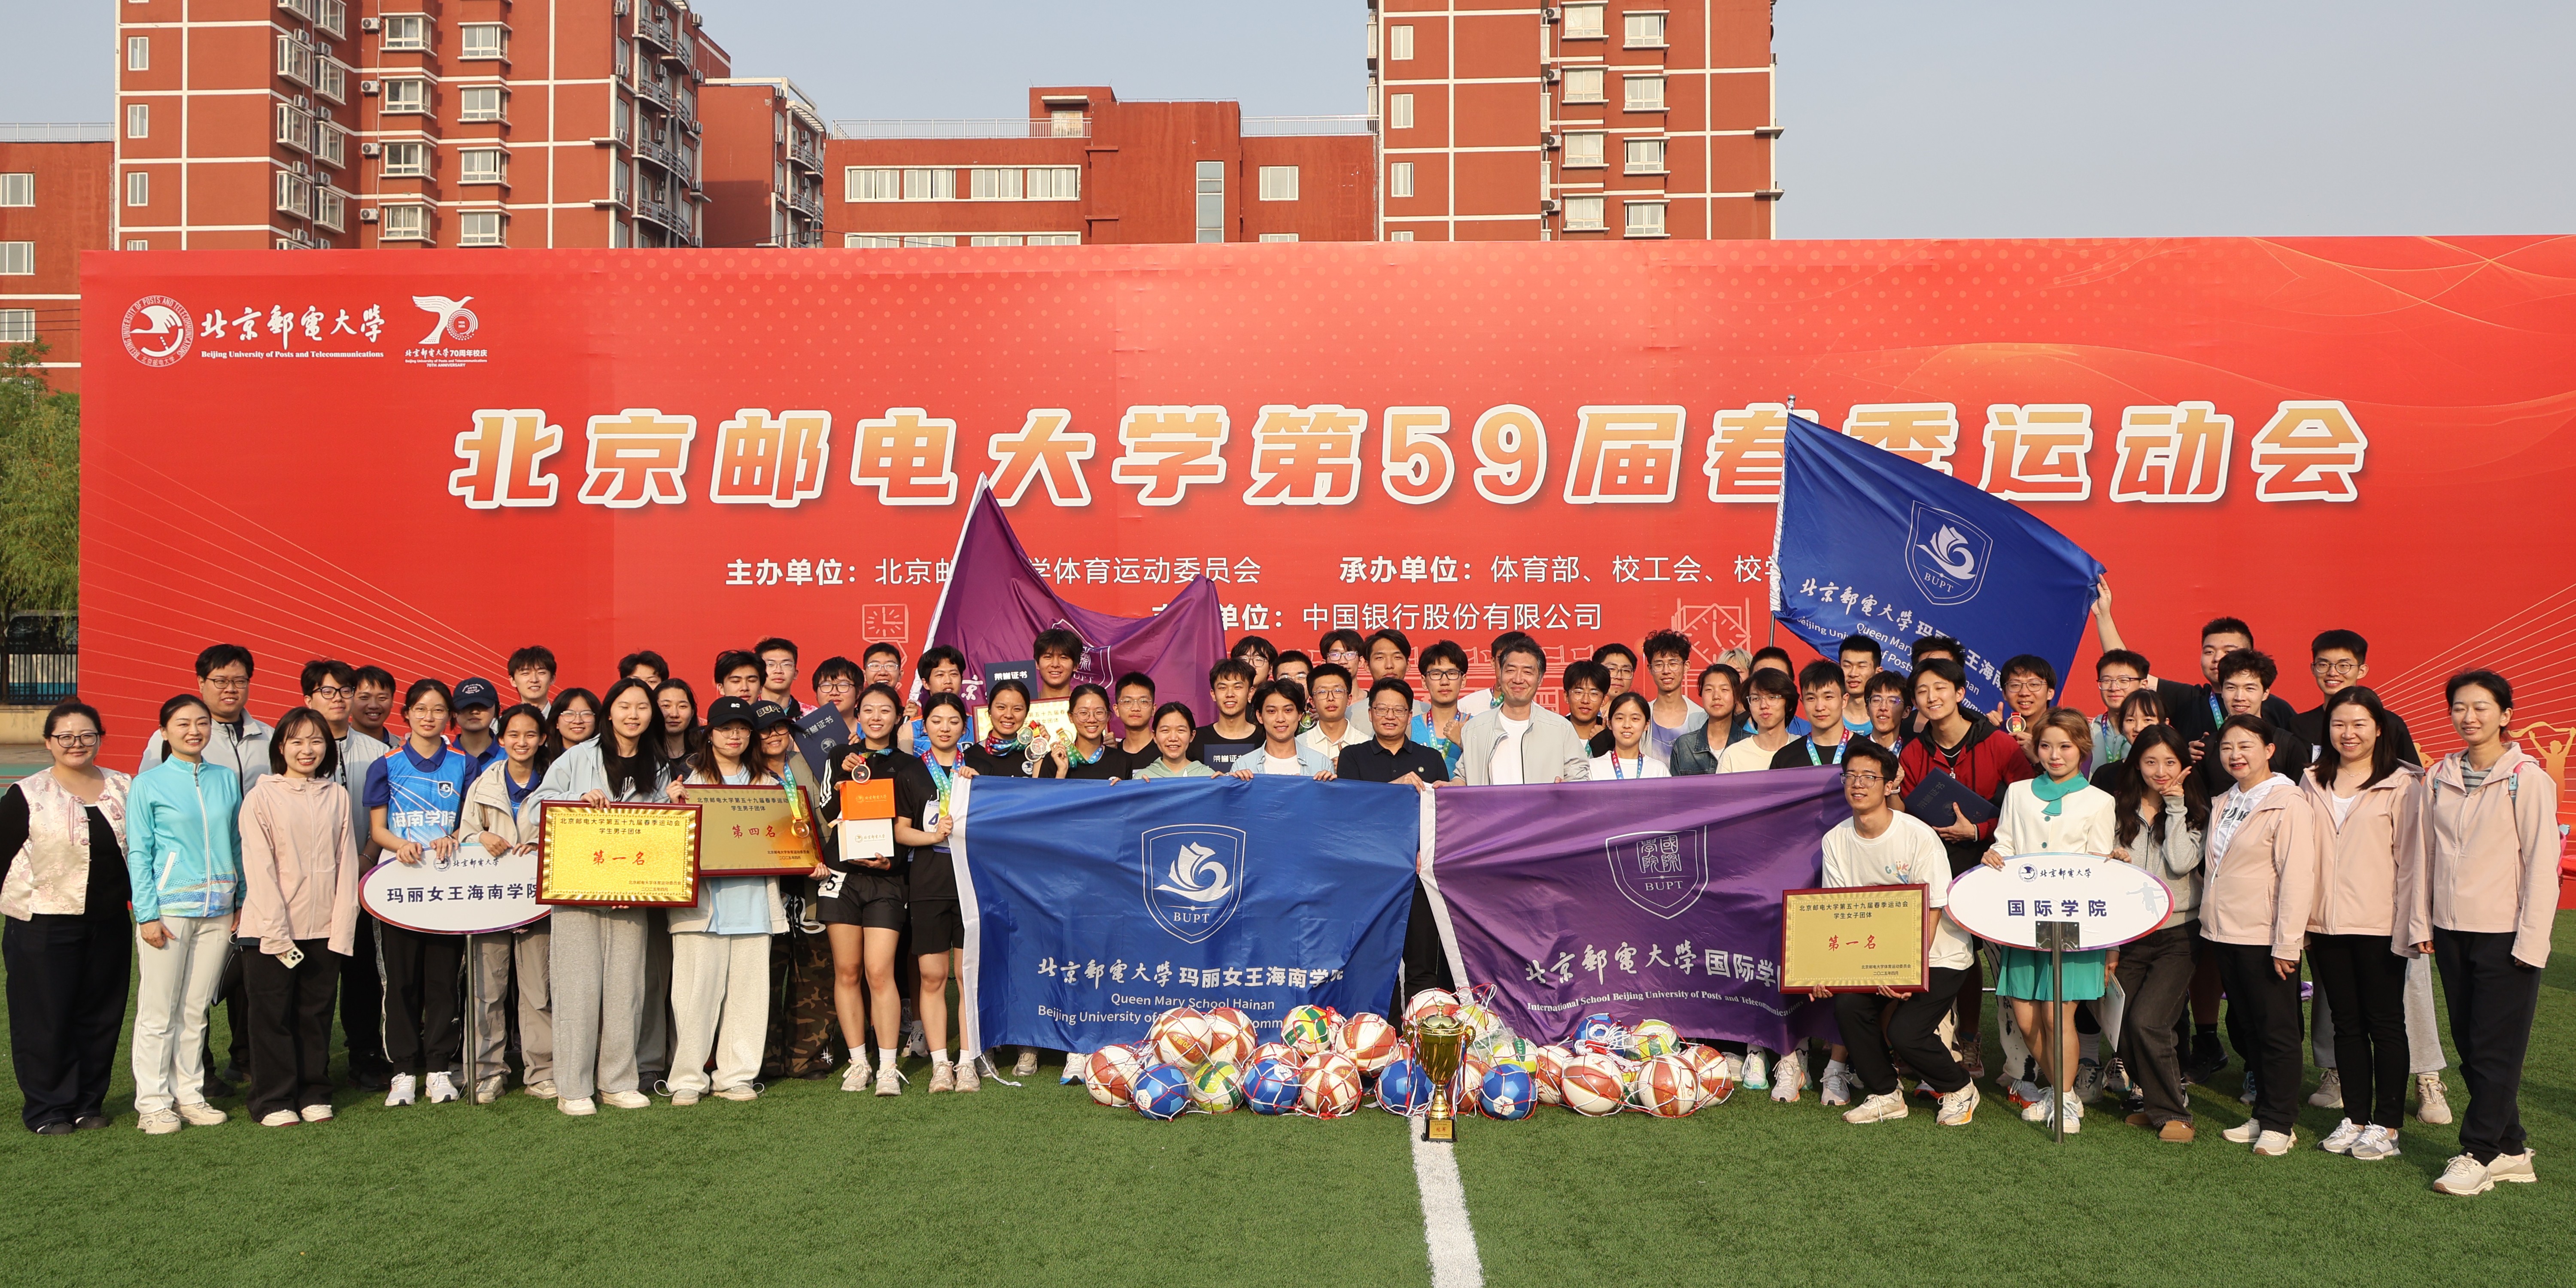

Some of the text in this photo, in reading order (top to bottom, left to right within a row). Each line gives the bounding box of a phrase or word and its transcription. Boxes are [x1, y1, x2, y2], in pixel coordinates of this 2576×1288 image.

[143, 296, 161, 305] POSTS
[162, 298, 174, 308] AND
[123, 308, 136, 338] UNIVERSITY
[173, 303, 192, 357] TELECOMMUNICATIONS
[125, 339, 140, 358] BEIJING
[141, 357, 175, 365] 北京邮电大学
[1924, 571, 1954, 593] BUPT
[1856, 623, 1888, 642] Queen
[994, 671, 1027, 680] 荣誉证书
[392, 811, 456, 828] 海南学院
[560, 817, 681, 826] 北京邮电大学第五十九届春季运动会
[732, 824, 775, 839] 第四名
[593, 849, 645, 866] 第一名
[387, 882, 537, 903] 玛丽女王海南学院
[1645, 881, 1683, 891] BUPT
[1799, 901, 1908, 911] 北京邮电大学第五十九届春季运动会
[2007, 899, 2107, 917] 国际学院
[1173, 912, 1210, 924] BUPT
[1828, 934, 1876, 952] 第一名
[1111, 993, 1275, 1010] Queen Mary School Hainan
[1527, 999, 1579, 1012] International
[1580, 993, 1610, 1005] School
[1613, 991, 1643, 1002] Beijing
[1645, 989, 1689, 1000] University
[1691, 990, 1700, 998] of
[1701, 990, 1722, 1000] Posts
[1724, 994, 1739, 1003] and
[1038, 1005, 1157, 1026] Beijing University of
